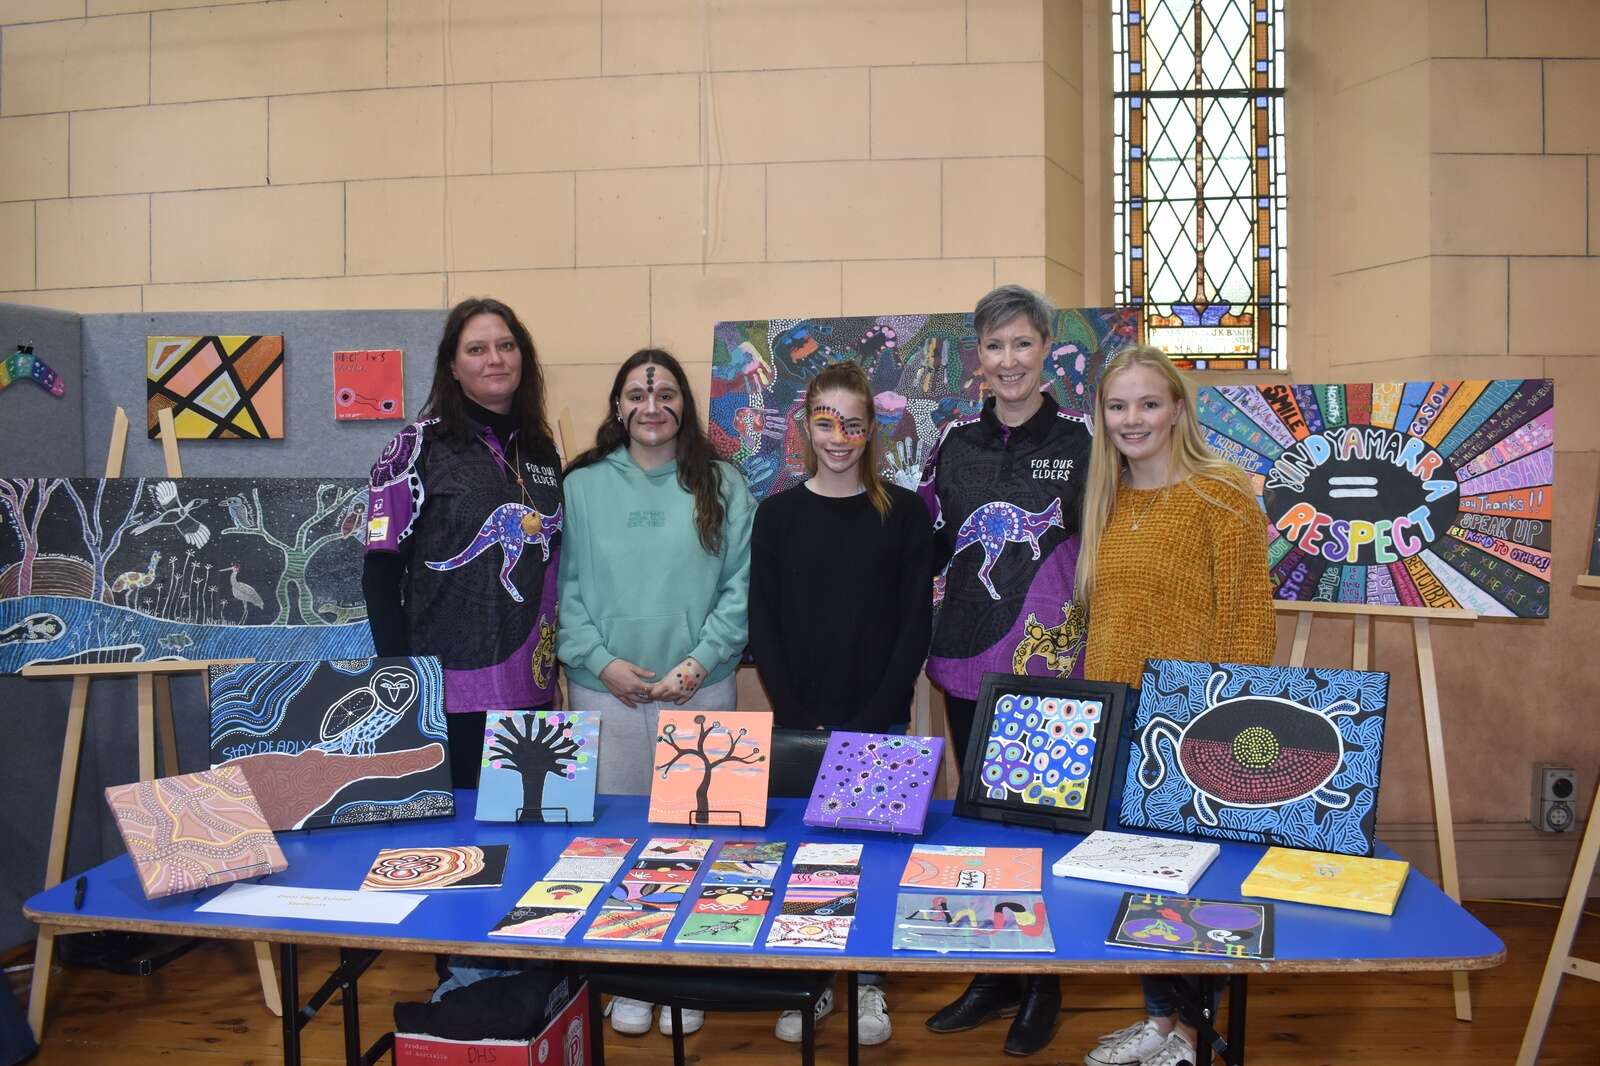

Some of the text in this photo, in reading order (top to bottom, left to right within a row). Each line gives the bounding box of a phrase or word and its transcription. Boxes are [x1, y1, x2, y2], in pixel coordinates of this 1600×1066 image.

[1262, 384, 1304, 432] SMILE
[1327, 385, 1341, 424] HONESTY
[525, 462, 541, 474] FOR
[1031, 459, 1074, 469] FOR OUR
[1032, 469, 1070, 481] ELDERS
[1265, 427, 1458, 503] YINDYAMARRA
[1477, 495, 1524, 512] Thanks
[1276, 502, 1436, 563] RESPECT
[1451, 527, 1465, 538] BE
[1494, 539, 1509, 555] TO
[1460, 513, 1543, 546] SPEAK UP
[1279, 563, 1309, 601] STOP
[1405, 556, 1417, 572] BE
[1413, 567, 1455, 609] HUMBLE
[222, 740, 314, 760] STAY DEADLY
[467, 1046, 497, 1064] DHS
